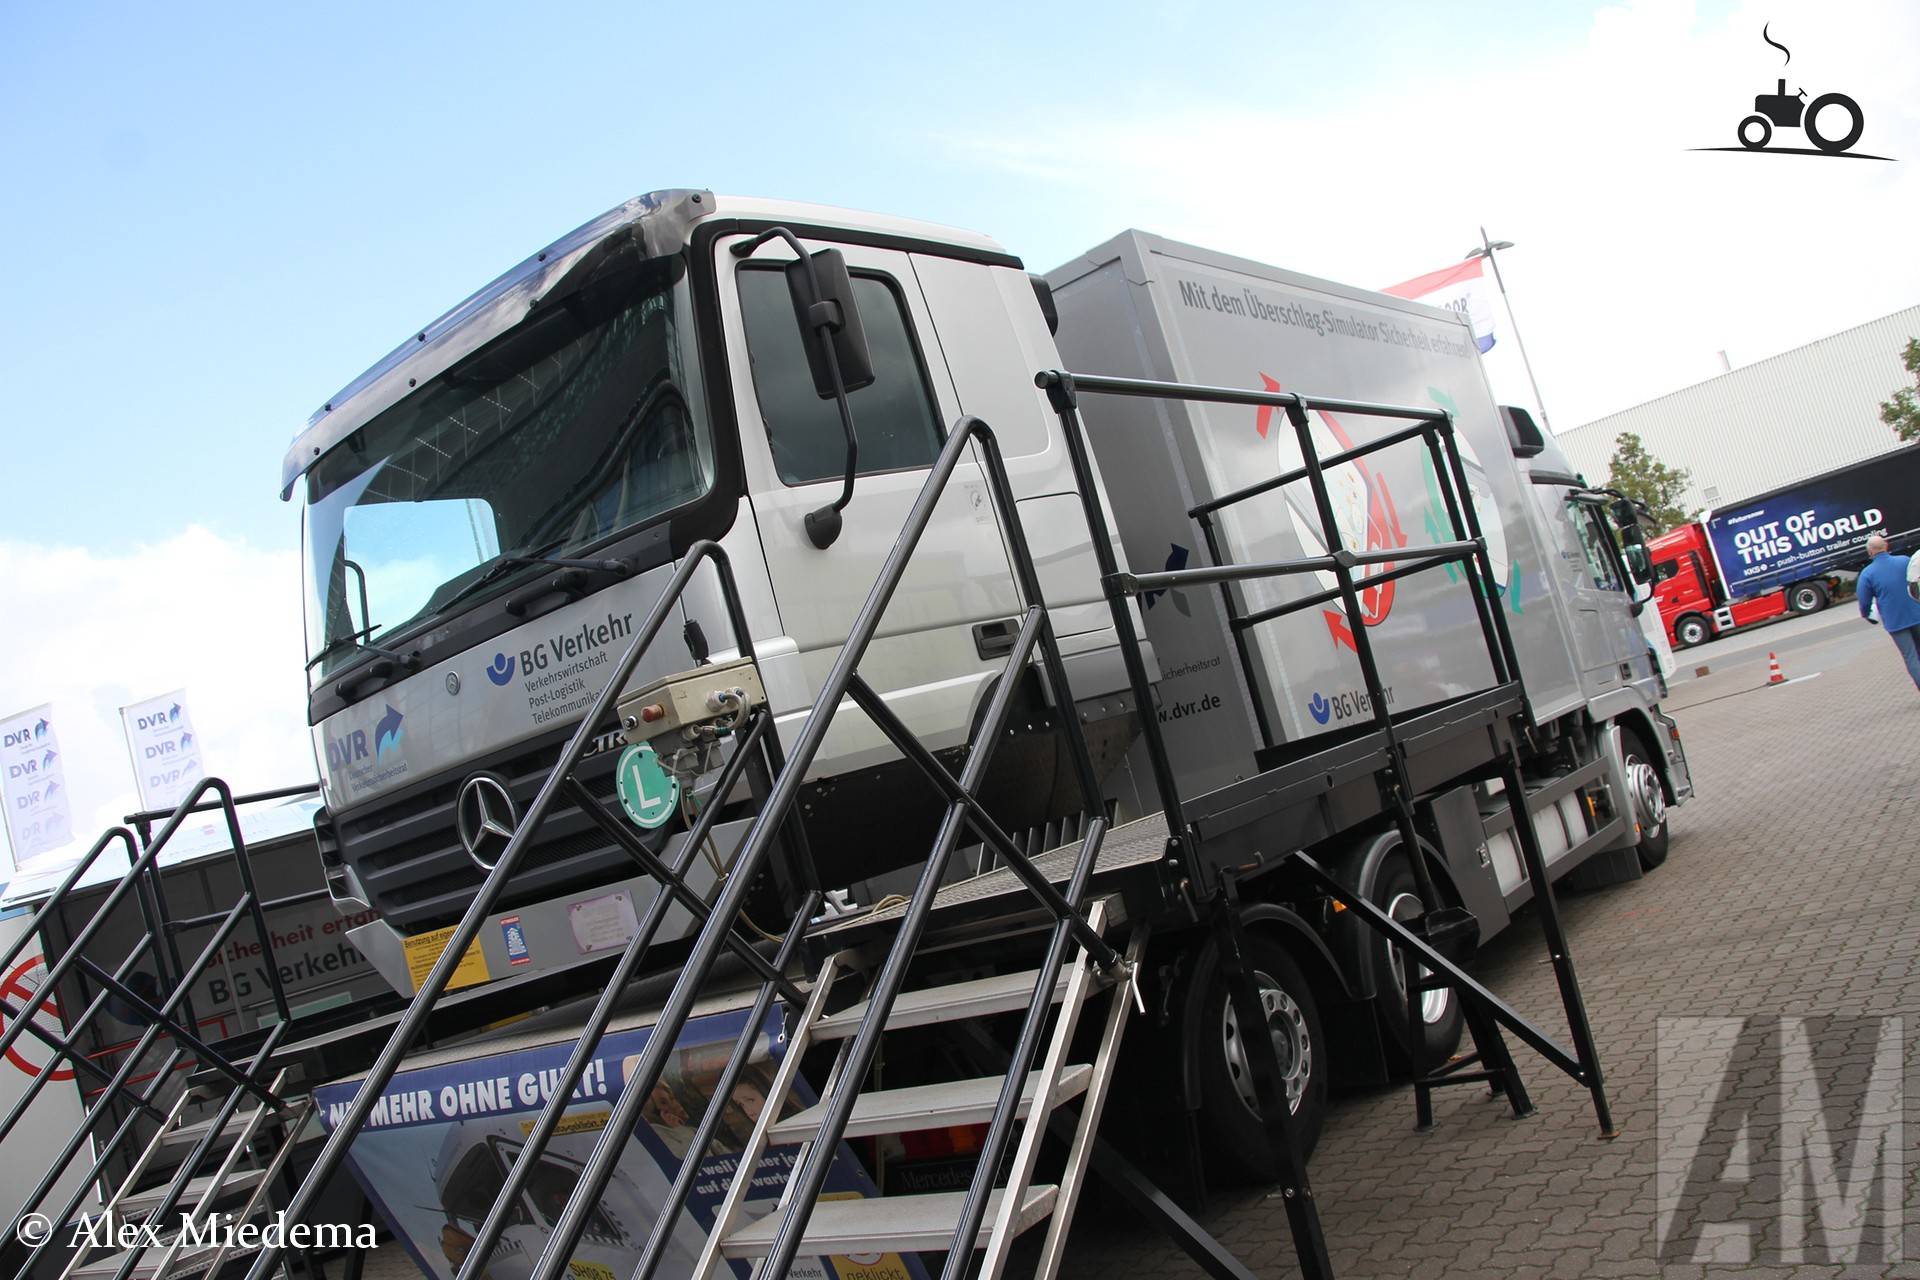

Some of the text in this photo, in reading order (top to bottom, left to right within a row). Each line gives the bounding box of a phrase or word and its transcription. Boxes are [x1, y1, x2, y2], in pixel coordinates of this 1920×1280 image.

[1178, 280, 1211, 310] Mit
[1211, 286, 1246, 317] dem
[1243, 288, 1380, 341] Überschlag-Simulator
[1379, 321, 1432, 352] Sicherheit
[1734, 510, 1816, 549] OUT OF
[1737, 508, 1883, 564] THIS WORLD
[1777, 546, 1826, 568] push-button
[1826, 539, 1851, 552] trailer
[1851, 528, 1888, 545] coupling
[519, 613, 632, 676] BG Verkehr
[525, 651, 608, 692] Verkehrswirtschaft
[529, 678, 587, 709] Post-Logistik
[532, 689, 603, 724] Telekommunika
[1331, 694, 1352, 720] BG
[3, 728, 32, 748] DVR
[137, 711, 168, 731] DVR
[145, 739, 177, 759] DVR
[327, 729, 369, 772] DVR
[9, 758, 39, 779] DVR
[149, 768, 181, 788] DVR
[631, 764, 661, 809] L
[207, 924, 315, 968] Sicheheit
[208, 972, 253, 1005] BG
[371, 1090, 436, 1127] MEHR
[441, 1077, 512, 1117] OHNE
[696, 1180, 720, 1195] auf
